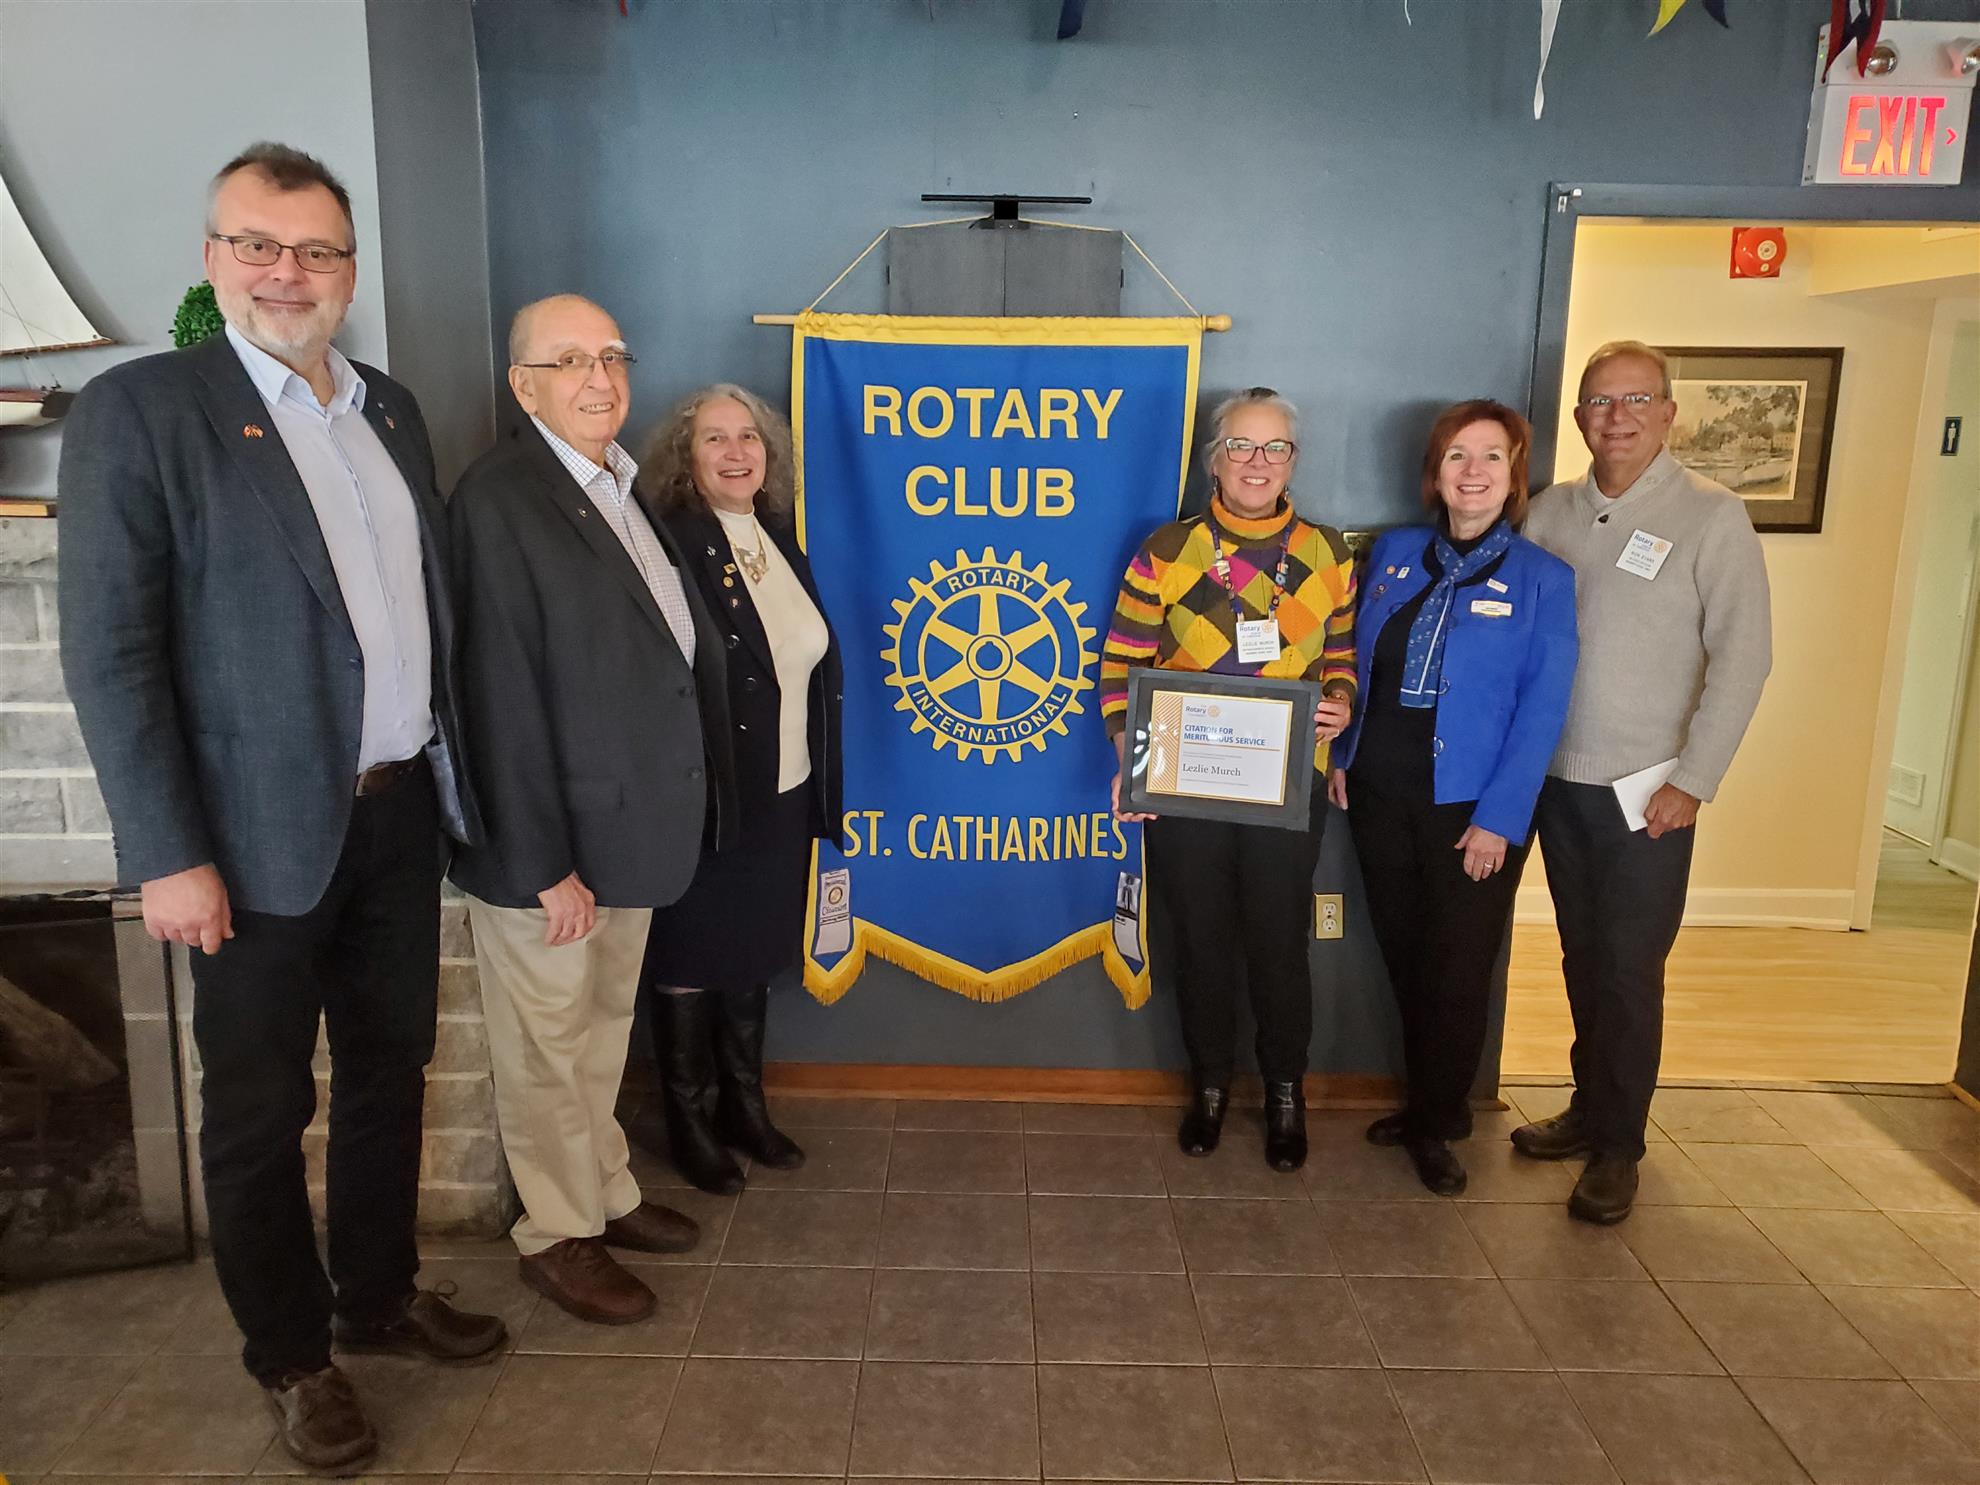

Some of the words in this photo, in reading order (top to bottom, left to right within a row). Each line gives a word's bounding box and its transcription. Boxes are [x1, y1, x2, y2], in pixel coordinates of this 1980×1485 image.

[1840, 95, 1946, 176] EXIT
[863, 384, 1124, 440] ROTARY
[904, 464, 1076, 517] CLUB
[1634, 534, 1654, 546] Rotary
[946, 568, 1035, 594] ROTARY
[910, 687, 1068, 744] INTERNATIONAL
[1185, 705, 1207, 714] Rotary
[1184, 724, 1217, 735] CITATION
[1218, 726, 1233, 735] FOR
[1235, 737, 1266, 746] SERVICE
[1182, 763, 1209, 774] Lezlie
[1210, 765, 1241, 777] Murch
[842, 810, 892, 858] ST.
[907, 811, 1128, 861] CATHARINES
